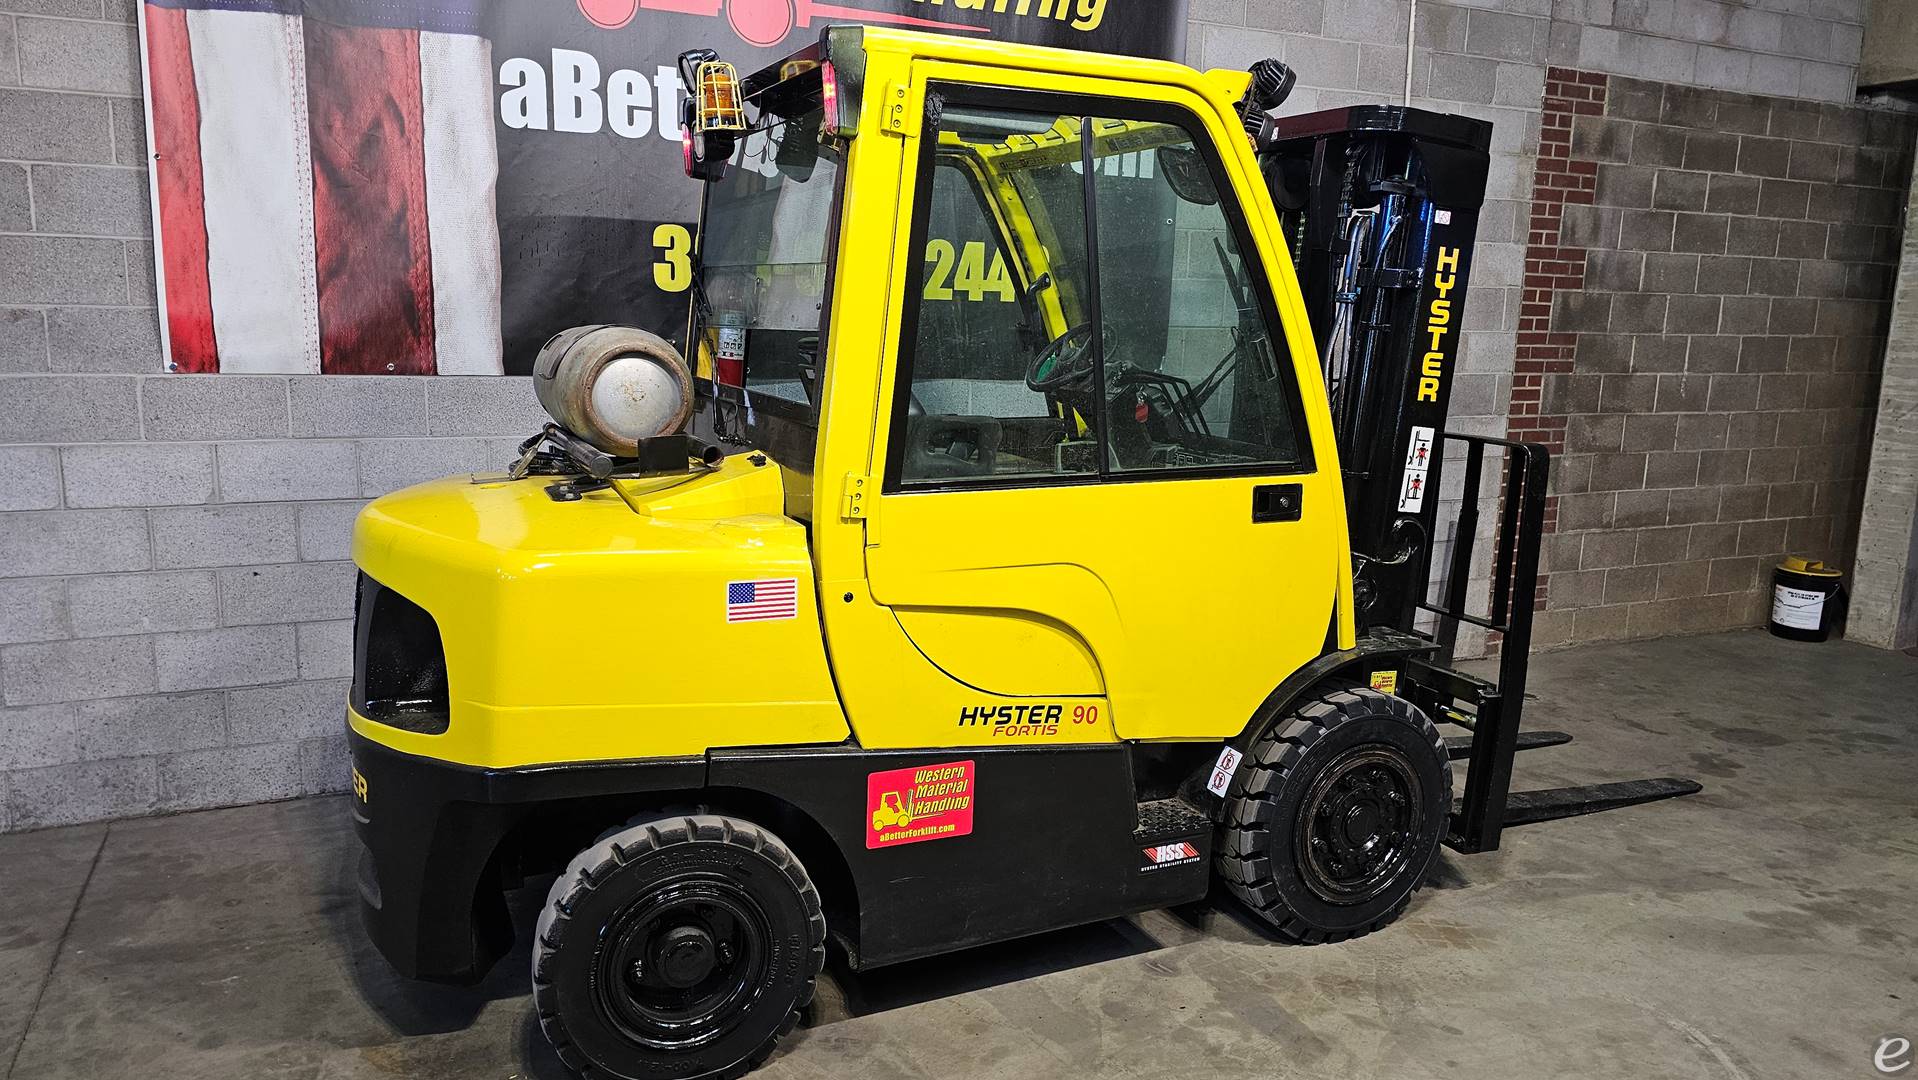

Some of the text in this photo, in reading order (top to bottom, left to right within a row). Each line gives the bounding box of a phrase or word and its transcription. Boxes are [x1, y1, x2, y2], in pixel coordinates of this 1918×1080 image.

[499, 47, 690, 142] aBet
[1417, 246, 1460, 402] HYSTER
[959, 705, 1098, 726] HYSTER 90
[993, 724, 1059, 737] FORTIS
[914, 766, 966, 784] Western
[915, 779, 969, 799] Material
[914, 796, 971, 815] Handling
[879, 824, 956, 842] aBetterForklift.com
[1155, 842, 1184, 863] HSS
